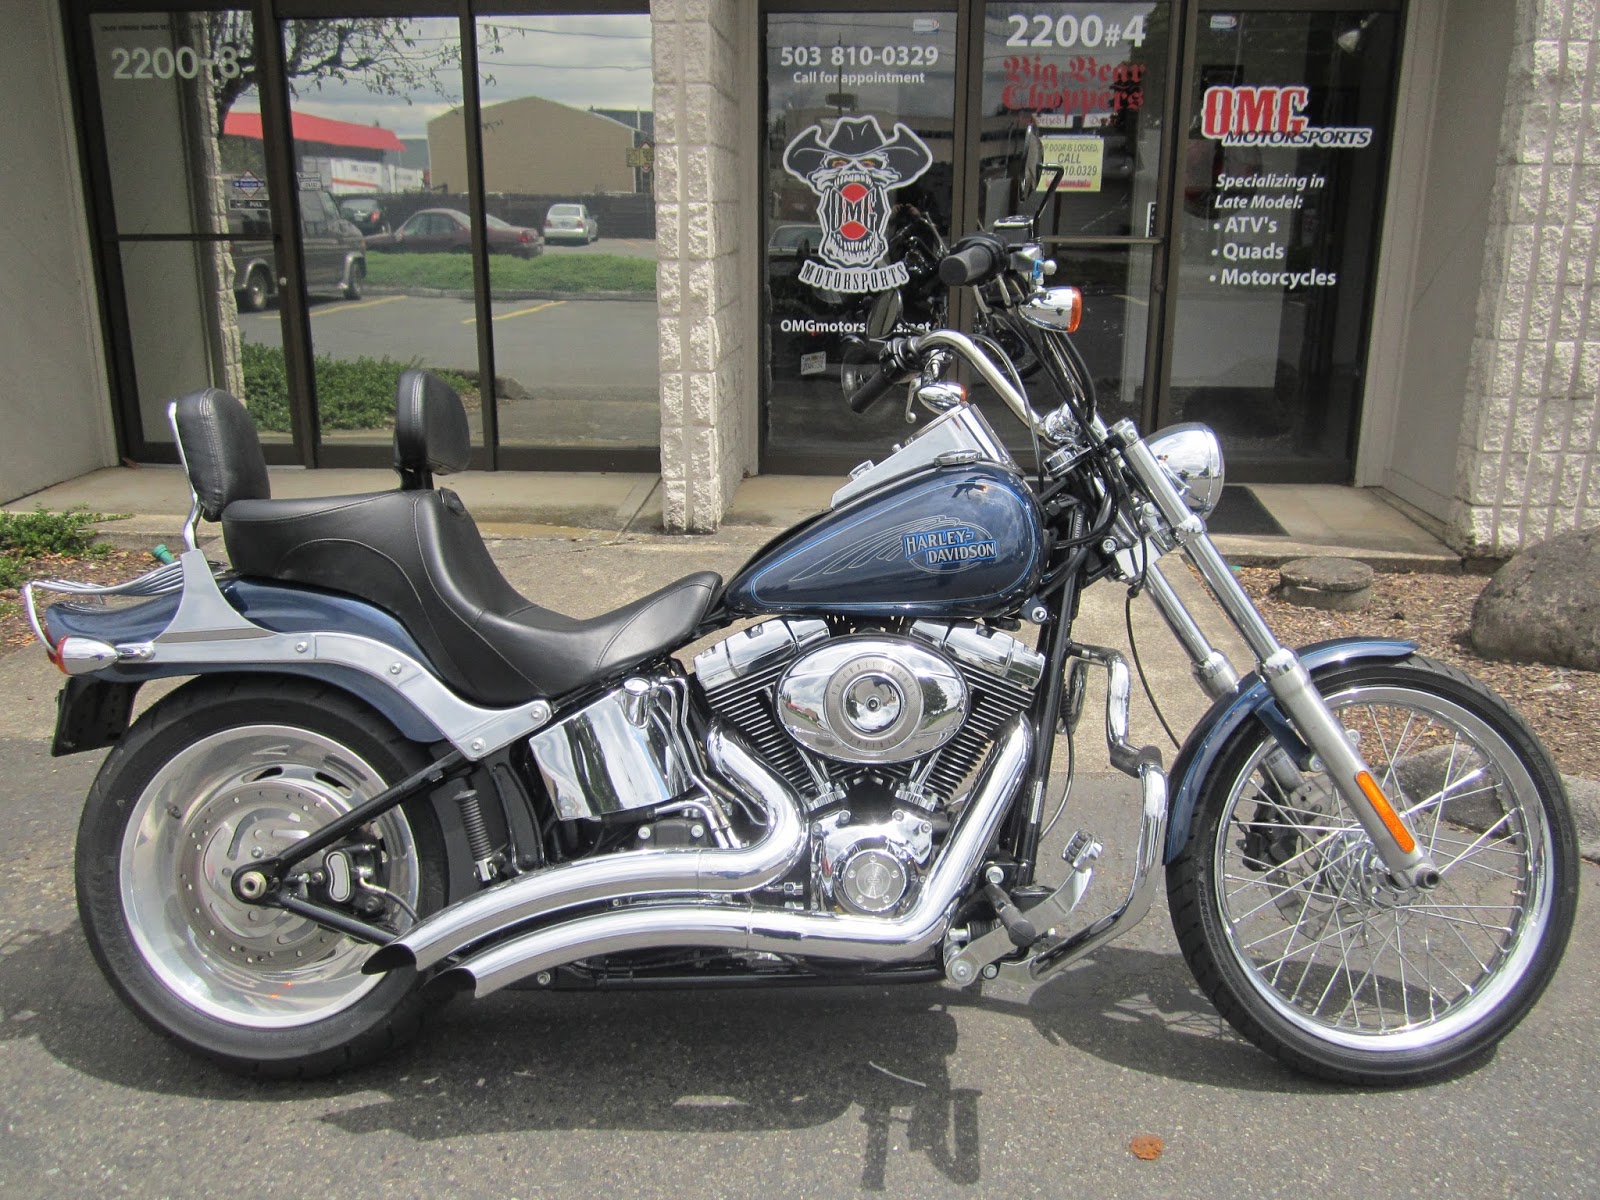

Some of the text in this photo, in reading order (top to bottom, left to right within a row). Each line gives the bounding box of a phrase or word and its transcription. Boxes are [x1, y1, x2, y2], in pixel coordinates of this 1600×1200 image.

[1006, 15, 1146, 47] 2200#4
[112, 46, 240, 79] 2200-8
[780, 46, 939, 66] 503 810-0329
[793, 71, 925, 87] Call for appointment
[1003, 55, 1146, 89] Big Bear
[1002, 84, 1144, 120] Choppers
[1203, 87, 1308, 138] OMG
[1050, 143, 1066, 151] DOOR
[1223, 129, 1371, 146] MOTORSPORTS
[1057, 153, 1082, 164] CALL
[1041, 164, 1098, 176] 10.0329
[1216, 174, 1325, 191] Specializing in
[1215, 195, 1303, 209] Late Model:
[1224, 216, 1277, 233] ATV's
[1223, 242, 1284, 261] Quads
[801, 262, 908, 290] MOTORSPORTS
[1221, 268, 1336, 289] Motorcycles
[780, 319, 931, 333] OMGmotorss.net
[906, 529, 971, 556] HARLEY-
[928, 543, 995, 563] DAVIDSON
